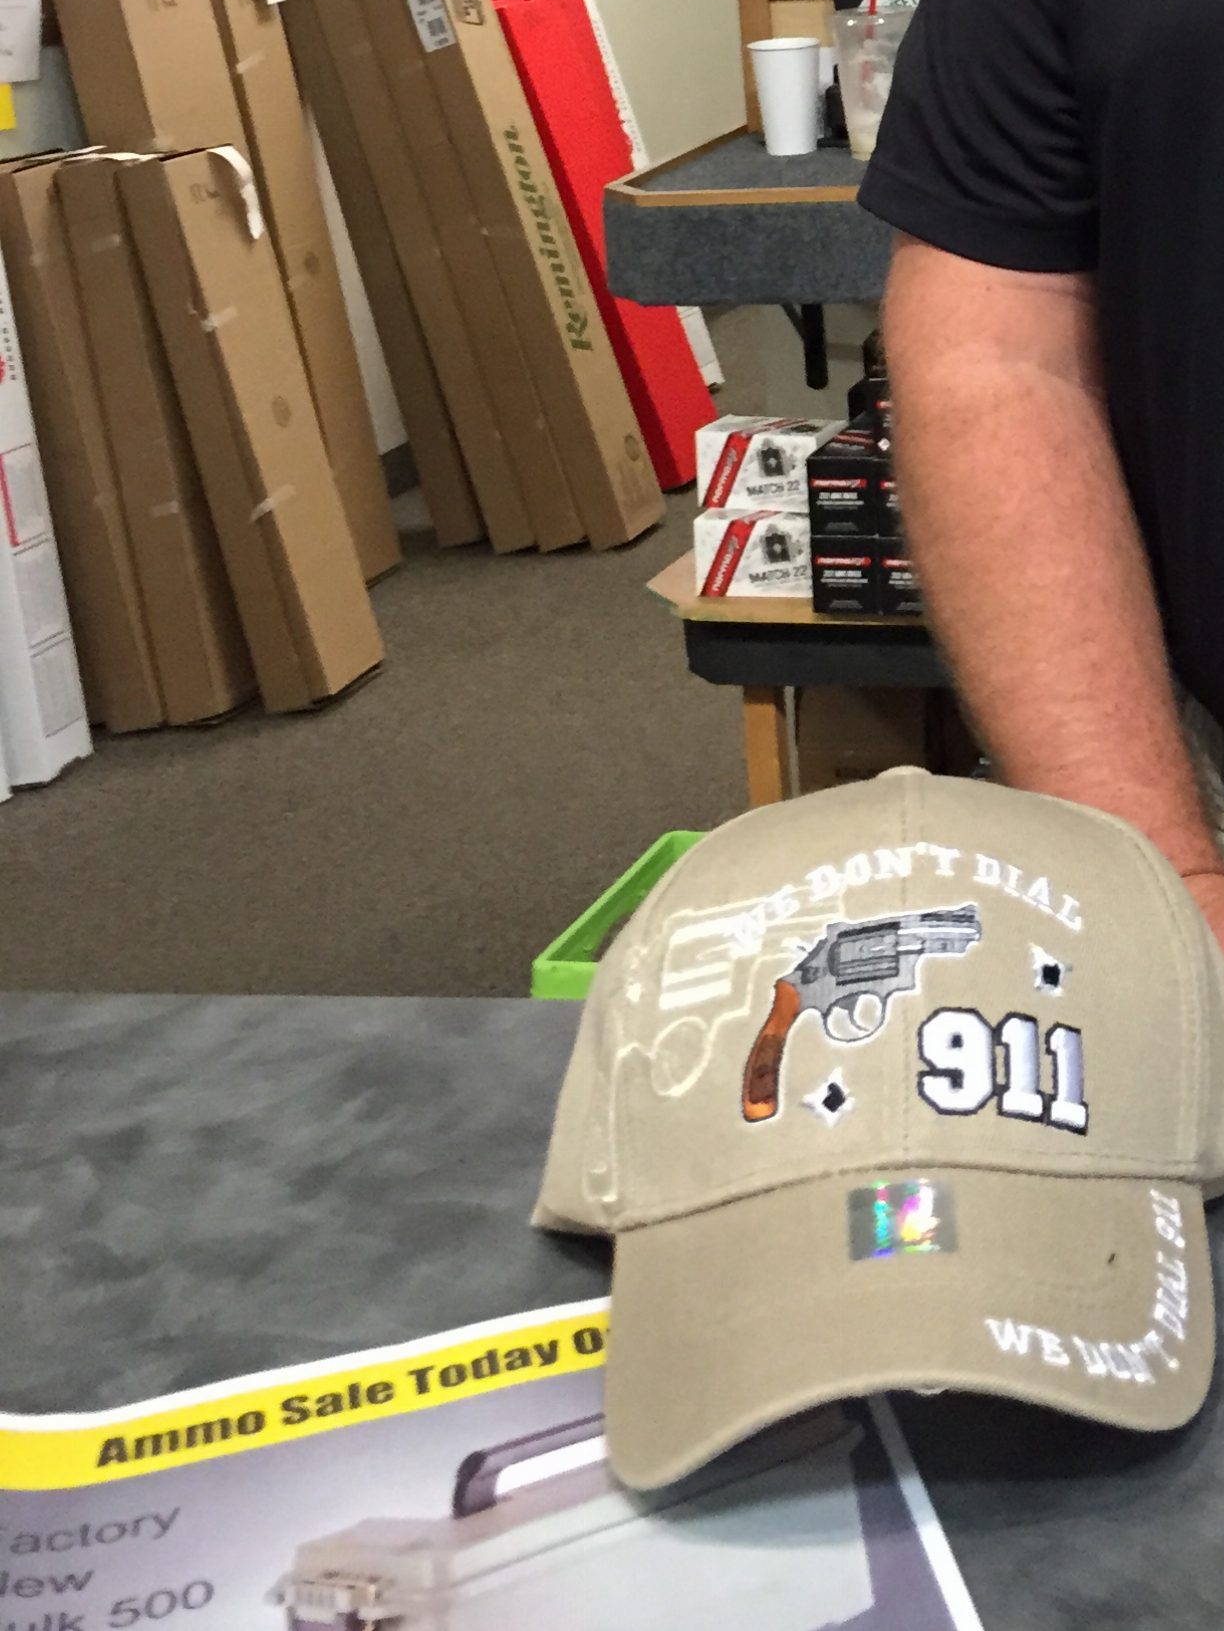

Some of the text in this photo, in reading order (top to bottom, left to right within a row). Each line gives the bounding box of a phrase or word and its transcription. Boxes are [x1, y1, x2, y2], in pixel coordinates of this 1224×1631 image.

[503, 125, 594, 351] Remington
[805, 841, 960, 902] DON'T
[973, 853, 1082, 931] DIAL
[916, 1007, 1089, 1136] 911
[984, 1318, 1070, 1366] WE
[97, 1409, 266, 1469] Ammo
[281, 1379, 395, 1427] Sale
[408, 1338, 560, 1396] Today
[0, 1506, 182, 1556] actory
[108, 1580, 215, 1629] 500
